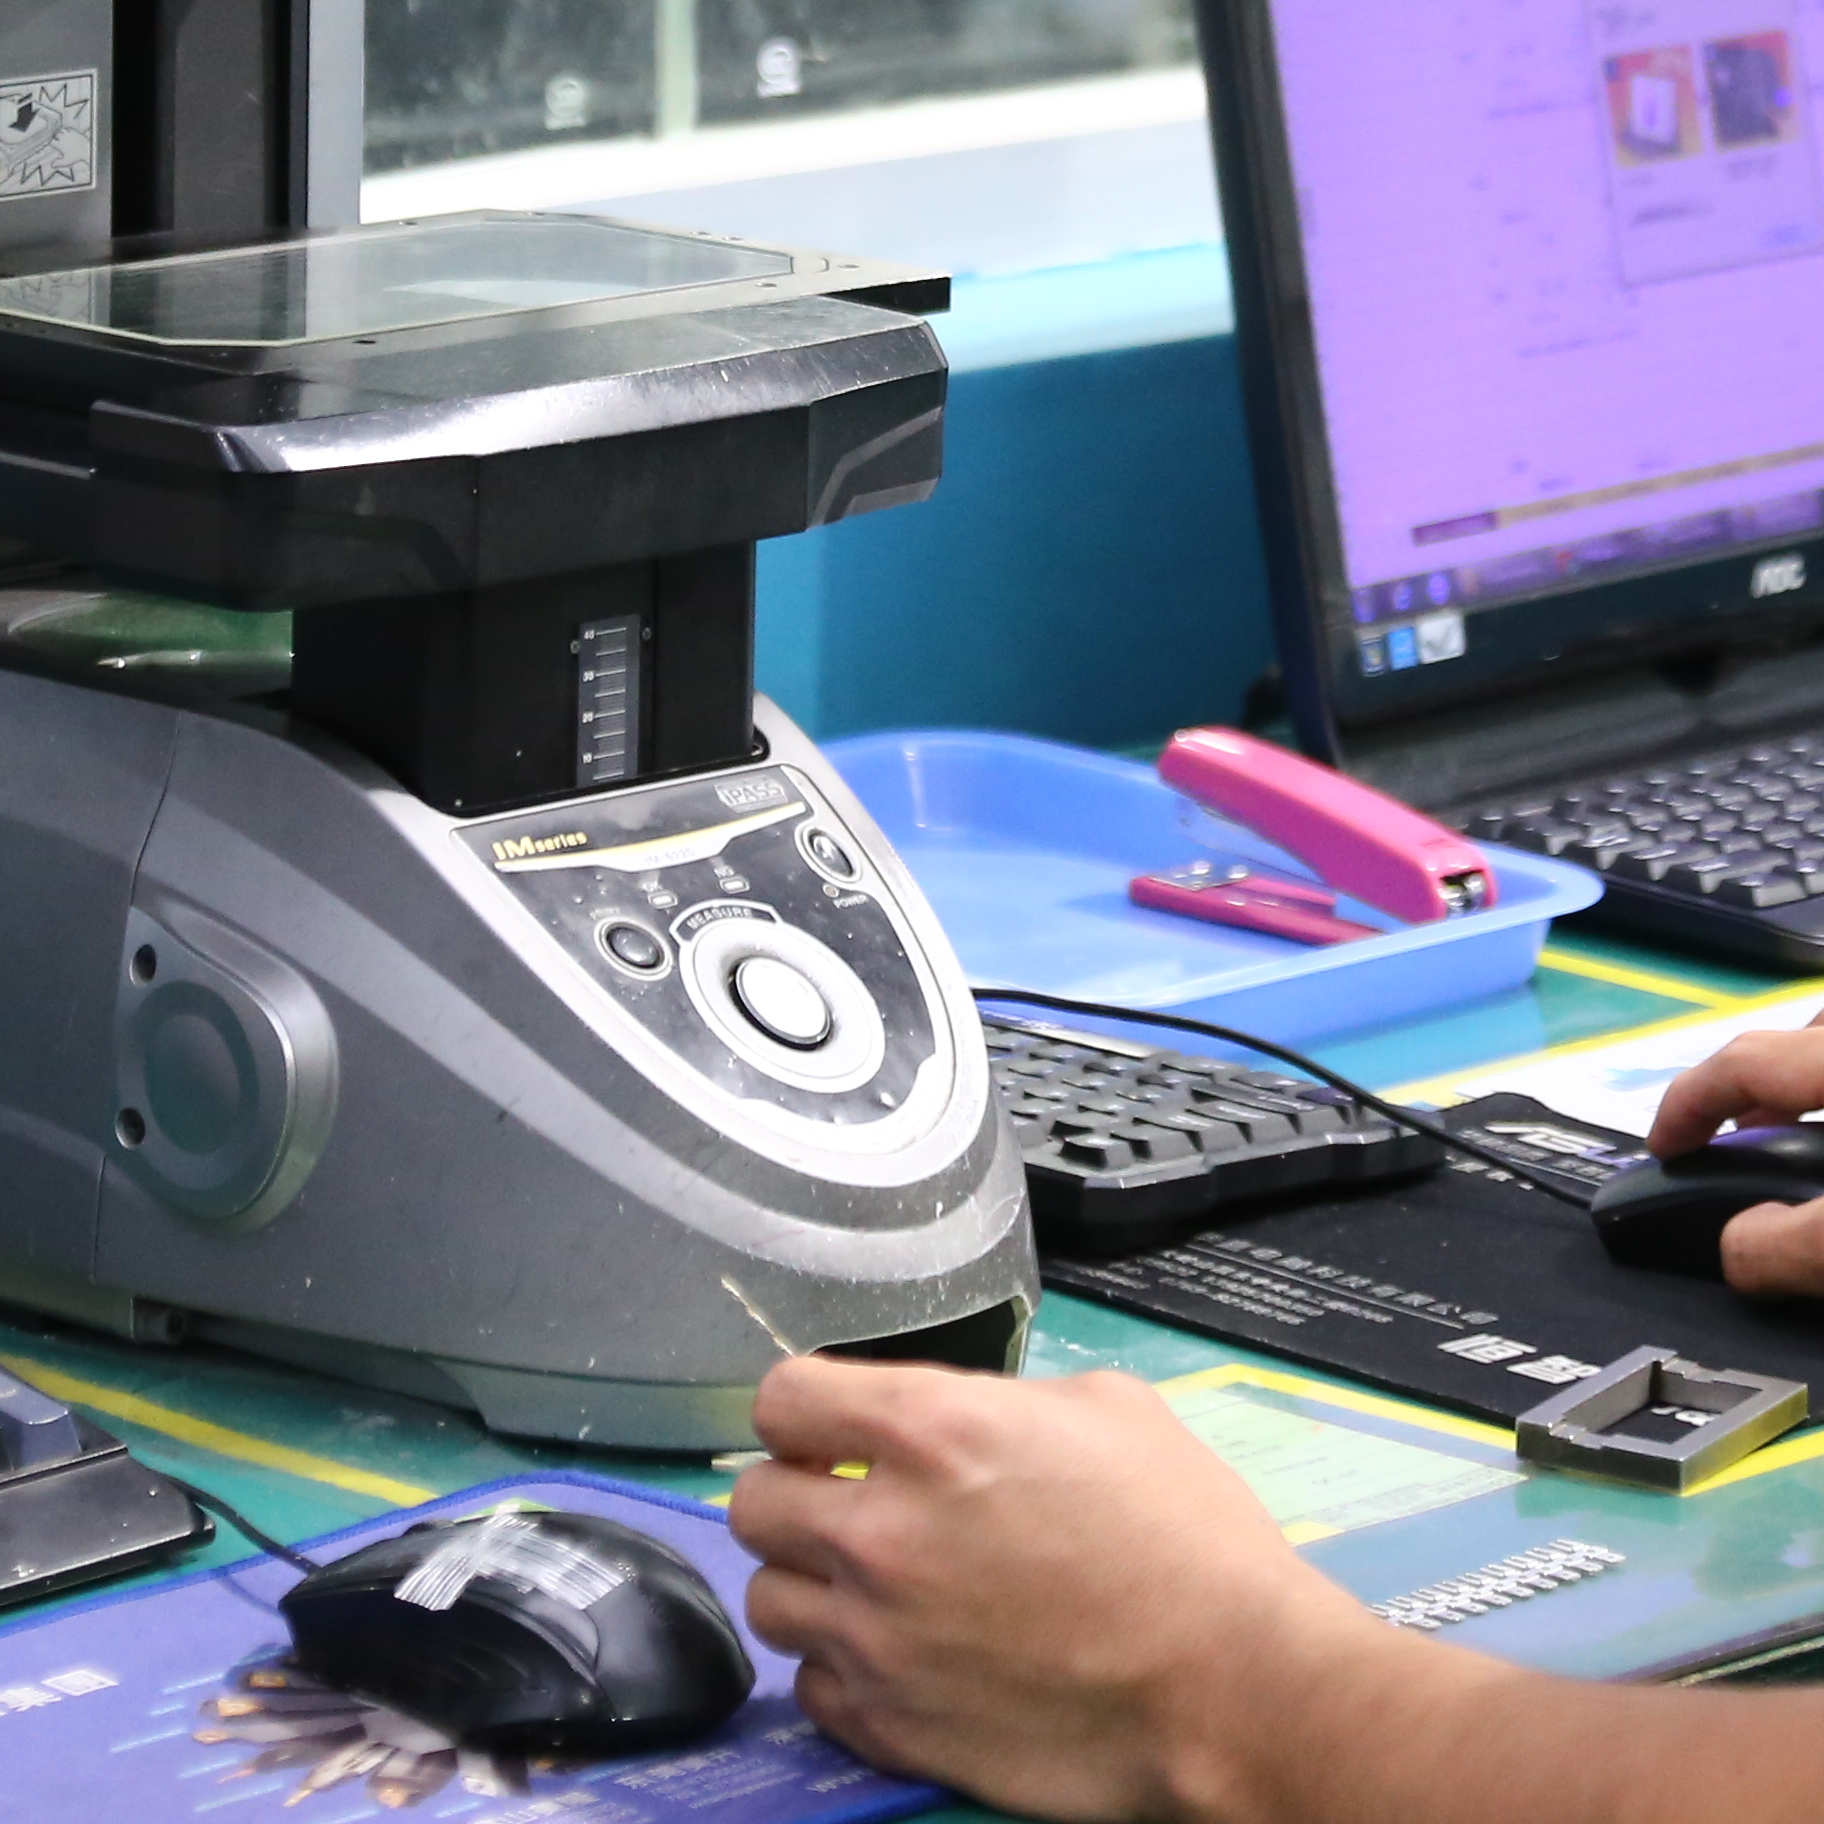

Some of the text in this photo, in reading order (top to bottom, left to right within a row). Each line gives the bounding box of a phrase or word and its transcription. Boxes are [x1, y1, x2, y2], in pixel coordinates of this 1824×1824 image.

[583, 670, 595, 682] 30
[582, 711, 594, 724] 20
[686, 905, 754, 931] MEASURE
[832, 893, 869, 910] POWER
